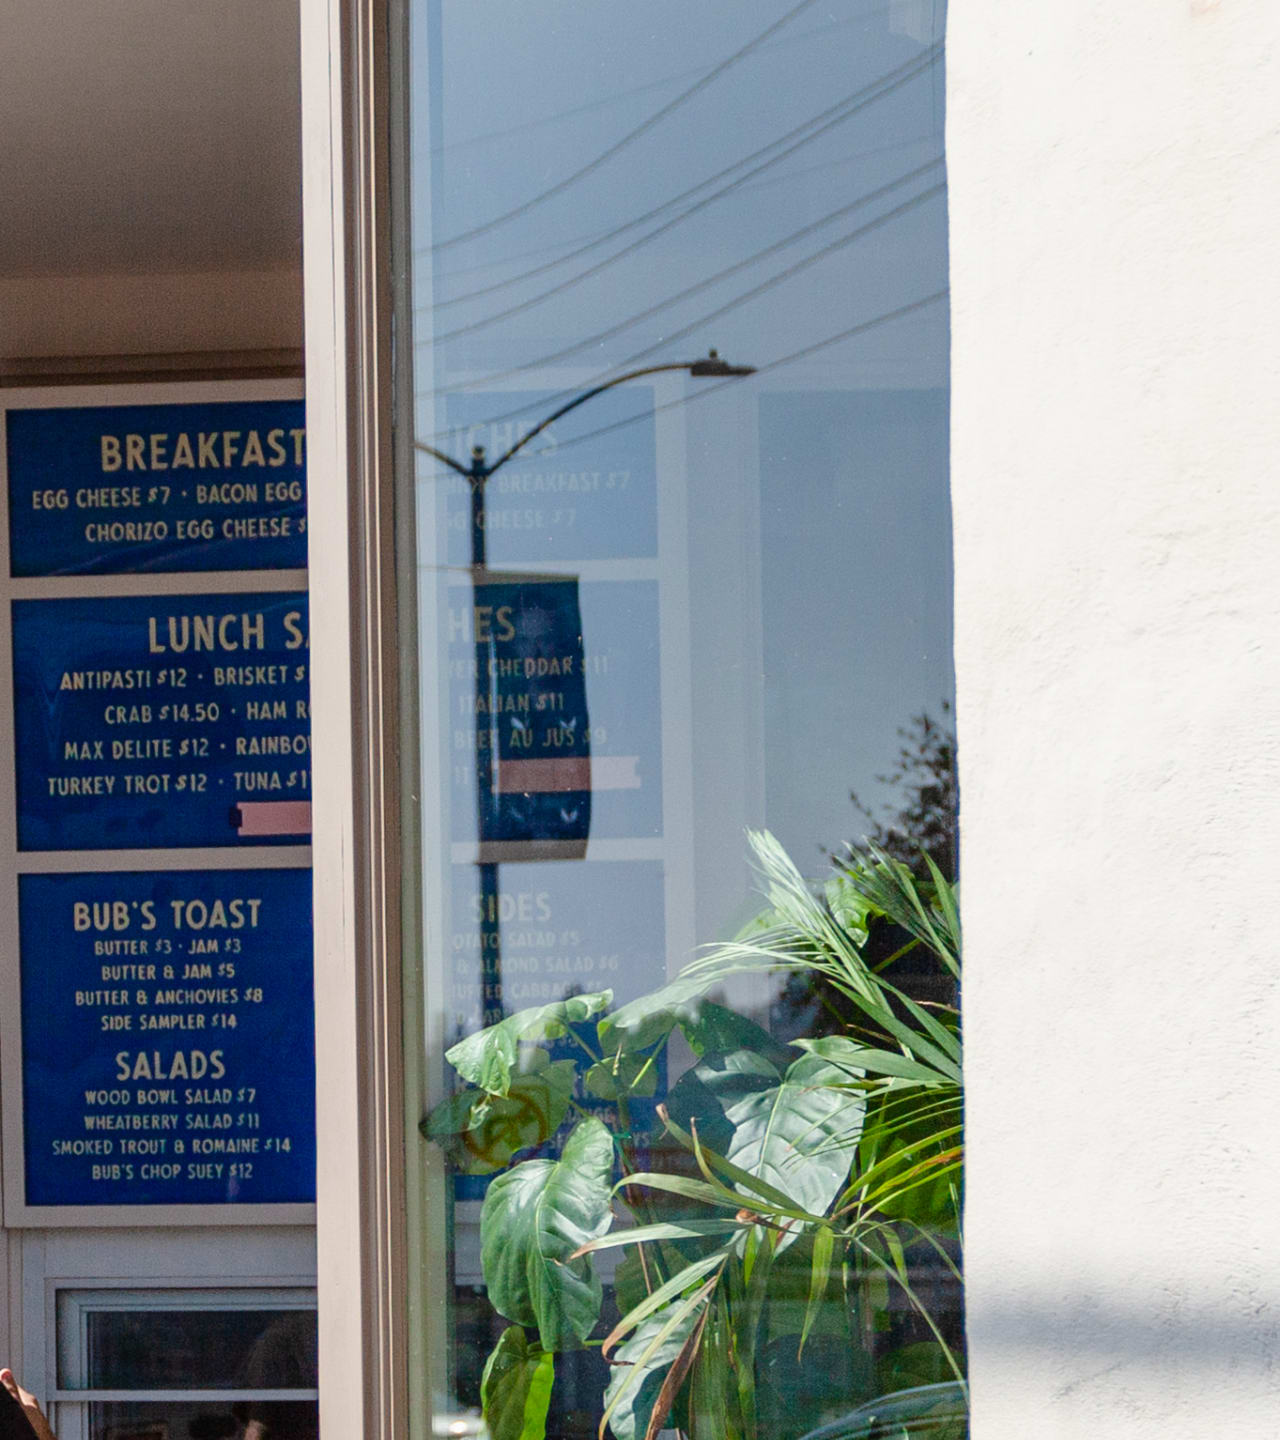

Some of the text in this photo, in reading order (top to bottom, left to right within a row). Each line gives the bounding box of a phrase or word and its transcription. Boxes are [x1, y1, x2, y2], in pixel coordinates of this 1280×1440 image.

[101, 428, 306, 472] BREAKFAST
[498, 473, 600, 493] BREAKFAST
[606, 471, 631, 489] $7
[33, 481, 301, 510] EGG CHEESE $7 BACON EGG
[85, 520, 168, 542] CHORIZO
[176, 519, 214, 540] EGG
[222, 517, 290, 538] CHEESE
[476, 509, 544, 530] CHEESE
[148, 611, 310, 654] LUNCH S
[488, 656, 573, 678] CHEDDAR
[60, 669, 151, 691] ANTIPASTI
[157, 668, 187, 689] $12
[214, 665, 287, 687] BRISKET
[104, 700, 310, 725] CRAB $14.50 HAM R
[459, 692, 564, 713] ITALIAN $11
[64, 735, 311, 761] MAX DELITE $12 RAINBO
[509, 727, 533, 748] AU
[542, 727, 575, 748] JUS
[48, 770, 311, 796] TURKEY TROT $12 TUNA $1
[73, 899, 262, 931] BUB'S TOAST
[470, 892, 552, 923] SIDES
[94, 938, 241, 956] BUTTER $3 JAM $3
[509, 932, 556, 948] SALAD
[101, 963, 235, 981] BUTTER & JAM $5
[544, 956, 593, 972] SALAD
[75, 988, 263, 1006] BUTTER & ANCHOVIES $8
[101, 1013, 237, 1031] SIDE SAMPLER $14
[115, 1050, 226, 1081] SALADS
[85, 1088, 256, 1105] WOOD BOWL SALAD $7
[84, 1113, 260, 1130] WHEATBERRY SALAD $11
[52, 1137, 291, 1156] SMOKED TROUT & ROMAINE $14
[92, 1163, 253, 1180] BUB'S CHOP SUEY $12
